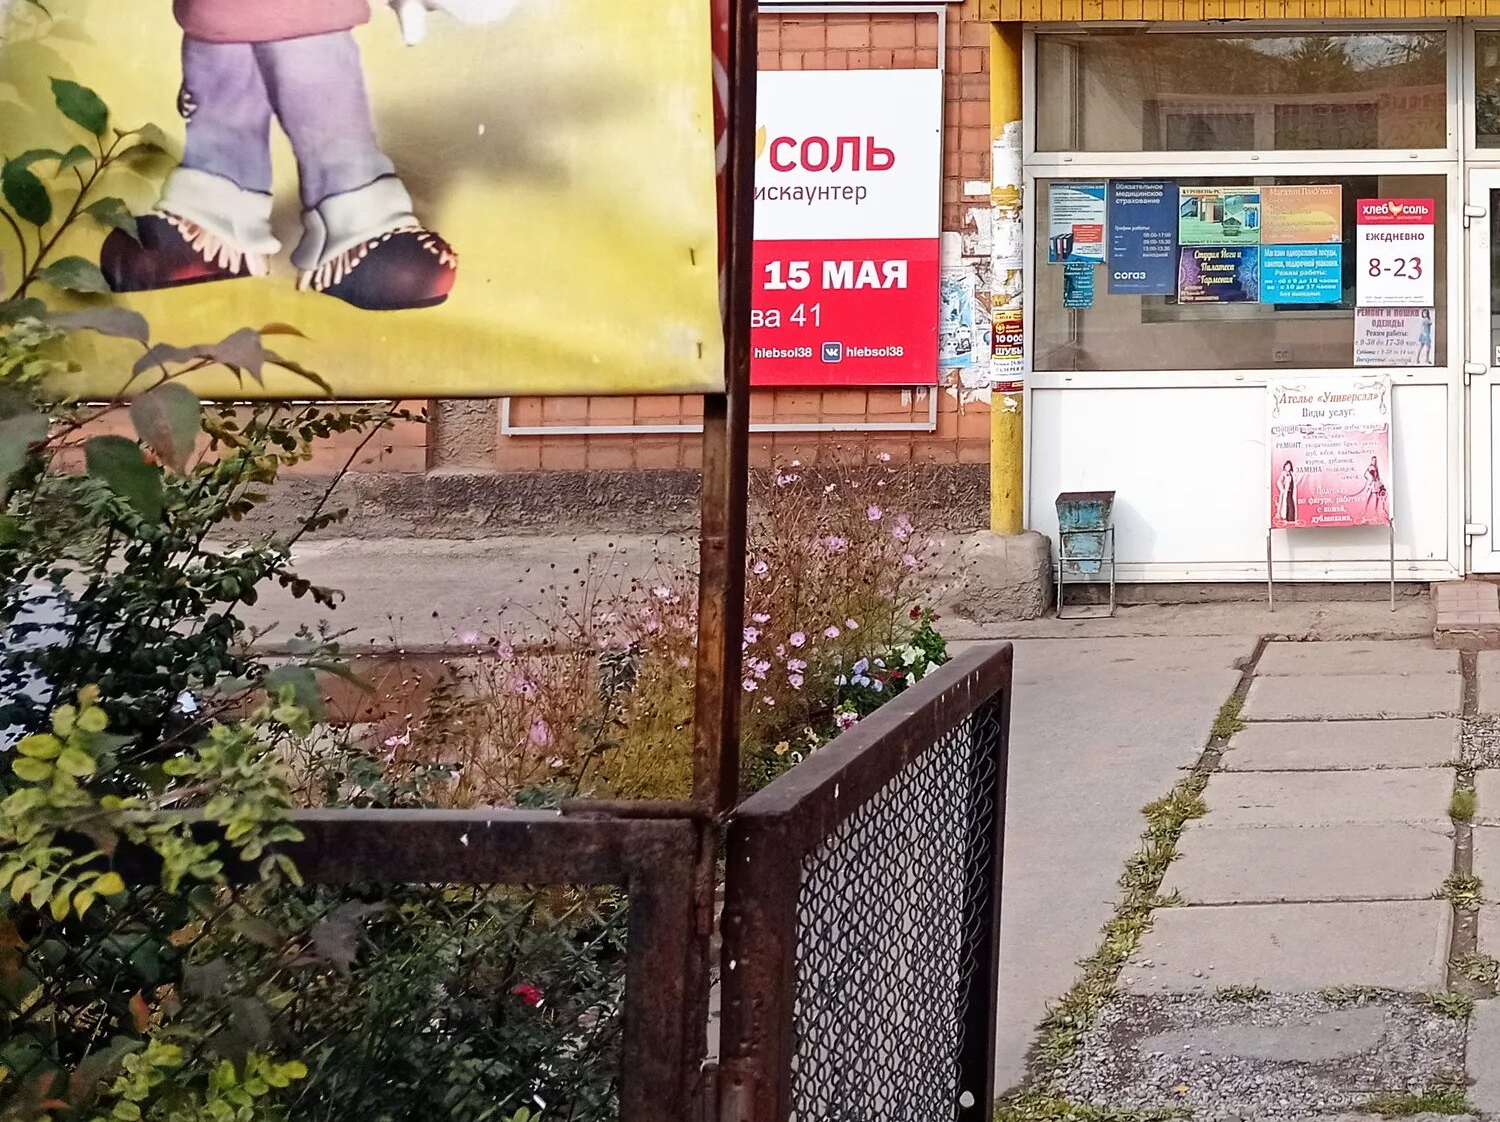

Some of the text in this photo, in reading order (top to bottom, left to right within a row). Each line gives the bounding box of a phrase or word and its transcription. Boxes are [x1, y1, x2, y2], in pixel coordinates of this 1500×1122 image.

[769, 136, 896, 173] соль
[1362, 204, 1429, 214] хлеб соль
[1366, 232, 1425, 242] ЕЖЕДНЕВНО
[764, 259, 909, 290] 15 МАЯ
[789, 302, 822, 327] 41
[1356, 308, 1384, 317] РЕМОНТ
[1371, 319, 1405, 328] ОДЕЖДЫ
[995, 334, 1006, 343] 10
[754, 347, 812, 358] hlebsol38
[846, 346, 904, 358] hlebsol38
[1279, 391, 1379, 404] Ателье «Универсал»
[1302, 408, 1325, 418] Виды
